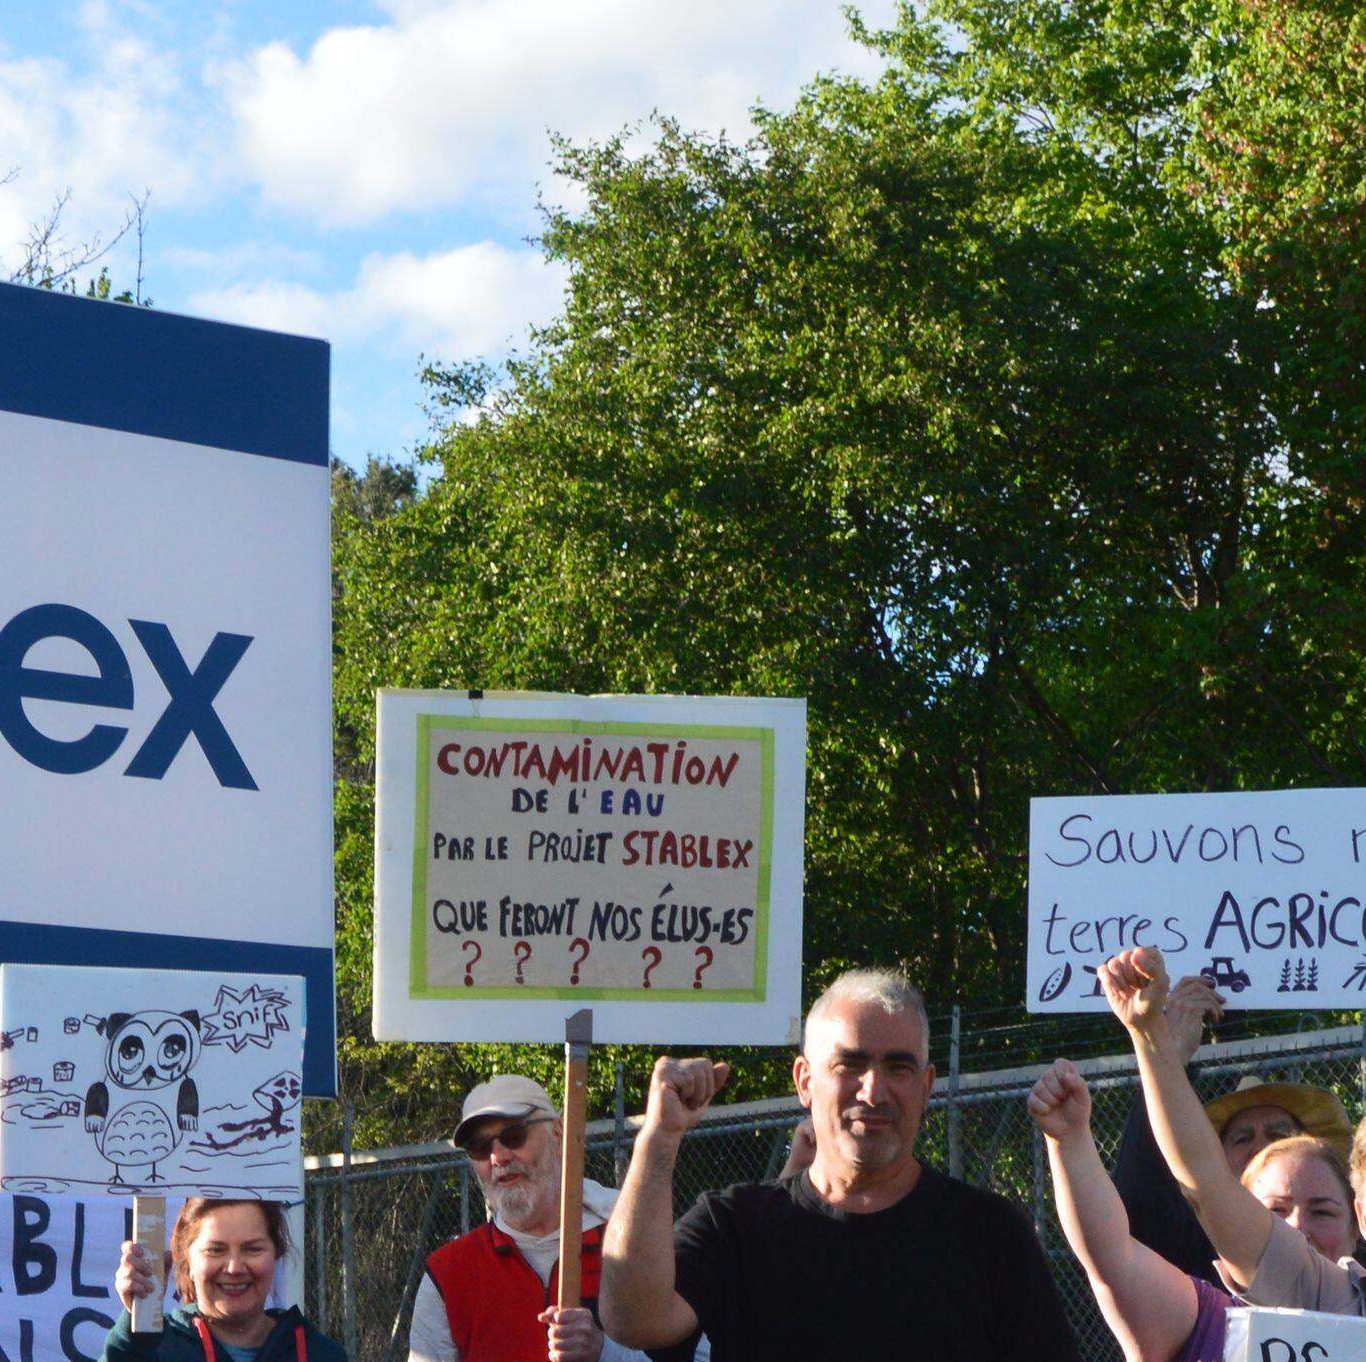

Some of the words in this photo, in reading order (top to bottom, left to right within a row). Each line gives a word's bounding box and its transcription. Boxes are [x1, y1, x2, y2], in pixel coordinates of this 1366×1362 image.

[512, 787, 548, 814] DE
[434, 832, 475, 861] PAR
[485, 836, 508, 861] LE
[622, 830, 754, 869] STABLEX
[1044, 813, 1306, 868] Sauvons
[432, 899, 488, 935] QUE
[498, 896, 580, 938] FERONT
[588, 901, 642, 943] NOS
[650, 883, 754, 946] ÉLUS-ES
[1043, 903, 1188, 956] terres
